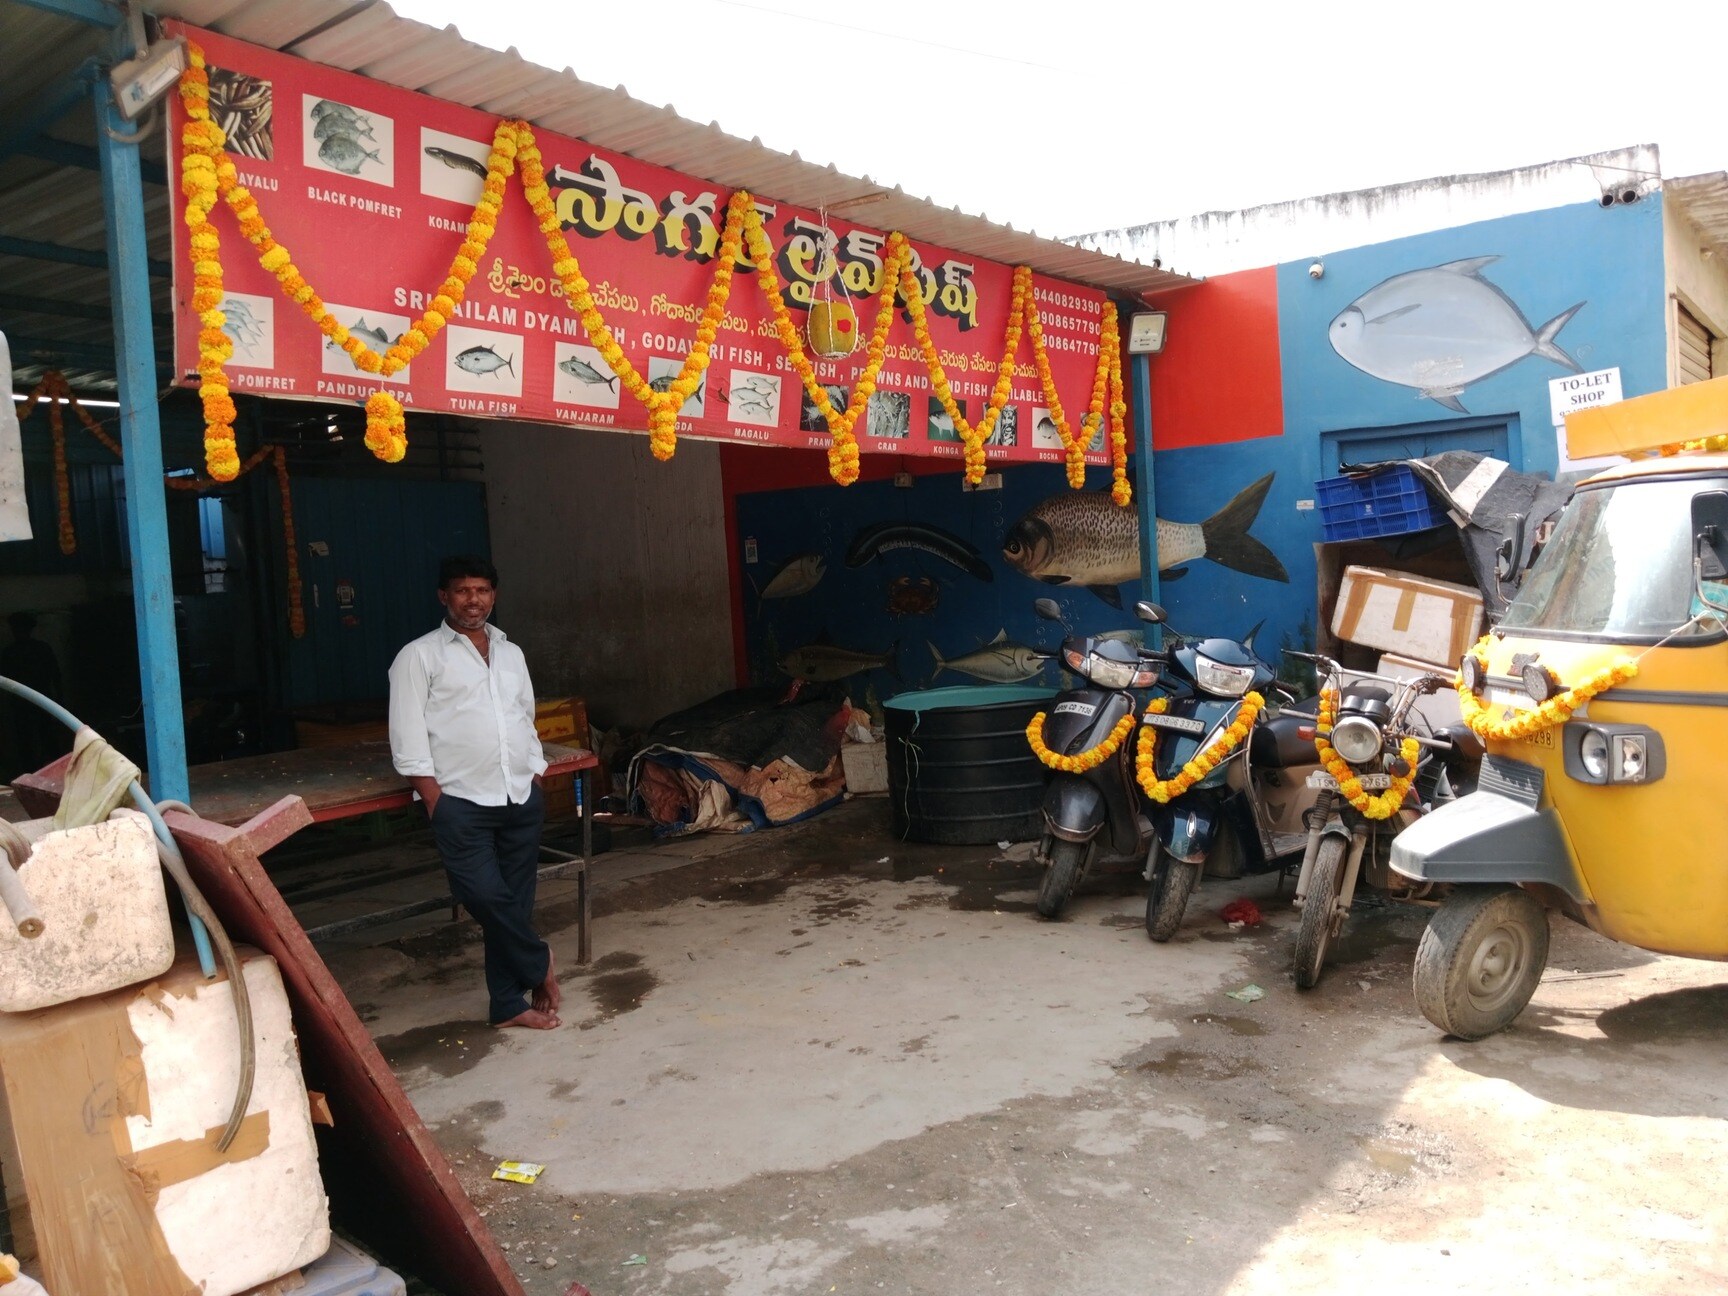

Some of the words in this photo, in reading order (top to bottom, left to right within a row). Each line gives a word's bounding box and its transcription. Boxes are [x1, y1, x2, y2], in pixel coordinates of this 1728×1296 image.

[307, 186, 347, 207] BLACK
[350, 196, 402, 219] POMFRET
[553, 153, 777, 269] సాగ
[428, 215, 471, 235] KORAM
[1033, 287, 1100, 315] 9440829390
[1036, 310, 1101, 336] 908657790
[524, 310, 577, 336] DYAM
[641, 331, 724, 360] GODARI
[904, 374, 928, 390] AND
[964, 382, 988, 397] FISH
[237, 374, 296, 391] POMFRET
[1560, 373, 1612, 392] TO-LET
[317, 380, 414, 404] PANDUGPPA
[1570, 391, 1606, 405] SHOP
[450, 398, 485, 411] TUNA
[488, 401, 517, 414] FISH
[556, 408, 615, 424] VANJARAM
[734, 427, 769, 440] MAGALU
[877, 442, 897, 451] CRAB
[988, 450, 1008, 458] MATTI
[1039, 452, 1059, 461] BOCHA
